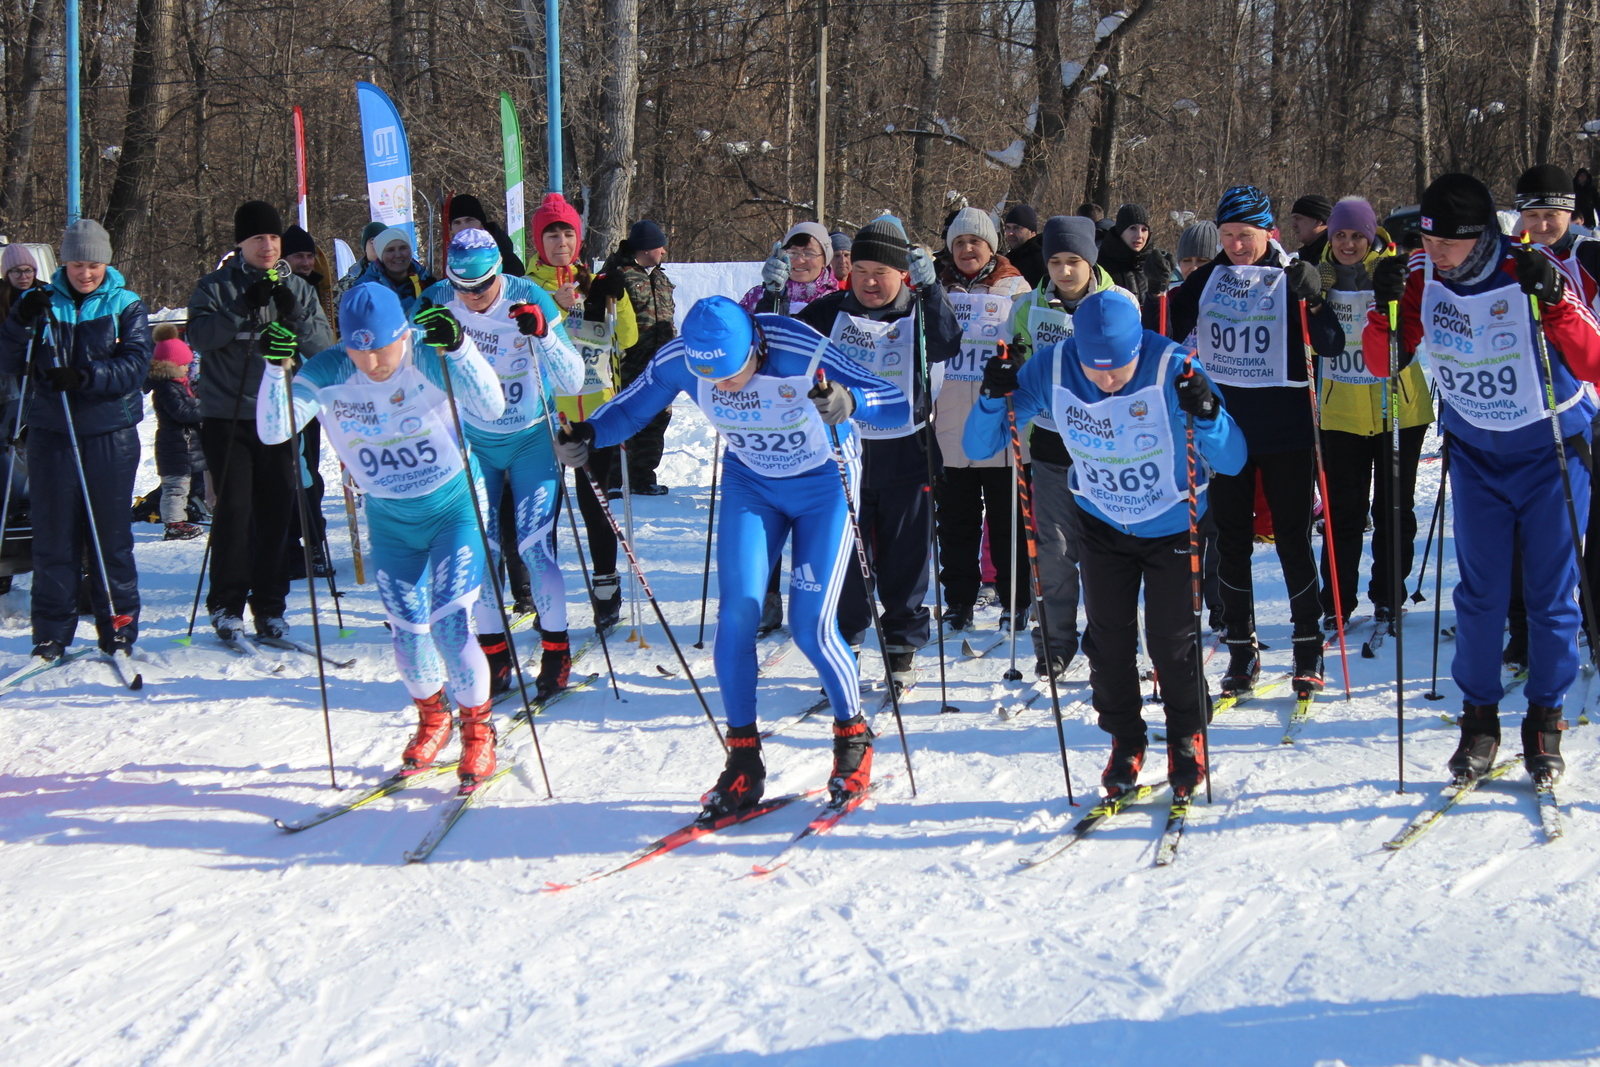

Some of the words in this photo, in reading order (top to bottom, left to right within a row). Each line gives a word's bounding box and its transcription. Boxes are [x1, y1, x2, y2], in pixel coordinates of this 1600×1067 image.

[1220, 273, 1250, 288] ЛЫЖНЯ
[1216, 282, 1248, 298] РОССИИ
[1211, 293, 1248, 312] 2022
[1037, 322, 1073, 337] ЛЫЖНЯ
[1433, 314, 1473, 339] РОССИИ
[1211, 322, 1270, 354] 9019
[1432, 329, 1474, 354] 2022
[685, 345, 726, 360] LUKOIL
[1213, 353, 1266, 366] РЕСПУБЛИКА
[1330, 350, 1366, 373] 900
[1490, 353, 1521, 365] ЖИЗНИ
[1206, 363, 1274, 377] БАШКОРТОСТАН
[1439, 365, 1517, 399] 9289
[712, 393, 761, 410] РОССИИ
[713, 406, 762, 422] 2022
[339, 421, 382, 437] 2022
[780, 417, 809, 431] ЖИЗНИ
[1067, 416, 1115, 439] РОССИИ
[727, 431, 807, 453] 9329
[1068, 429, 1116, 451] 2022
[359, 439, 438, 478] 9405
[1100, 456, 1130, 465] НОРМА
[1131, 448, 1164, 463] ЖИЗНИ
[373, 465, 442, 487] РЕСПУБЛИКА
[1082, 461, 1160, 493] 9369
